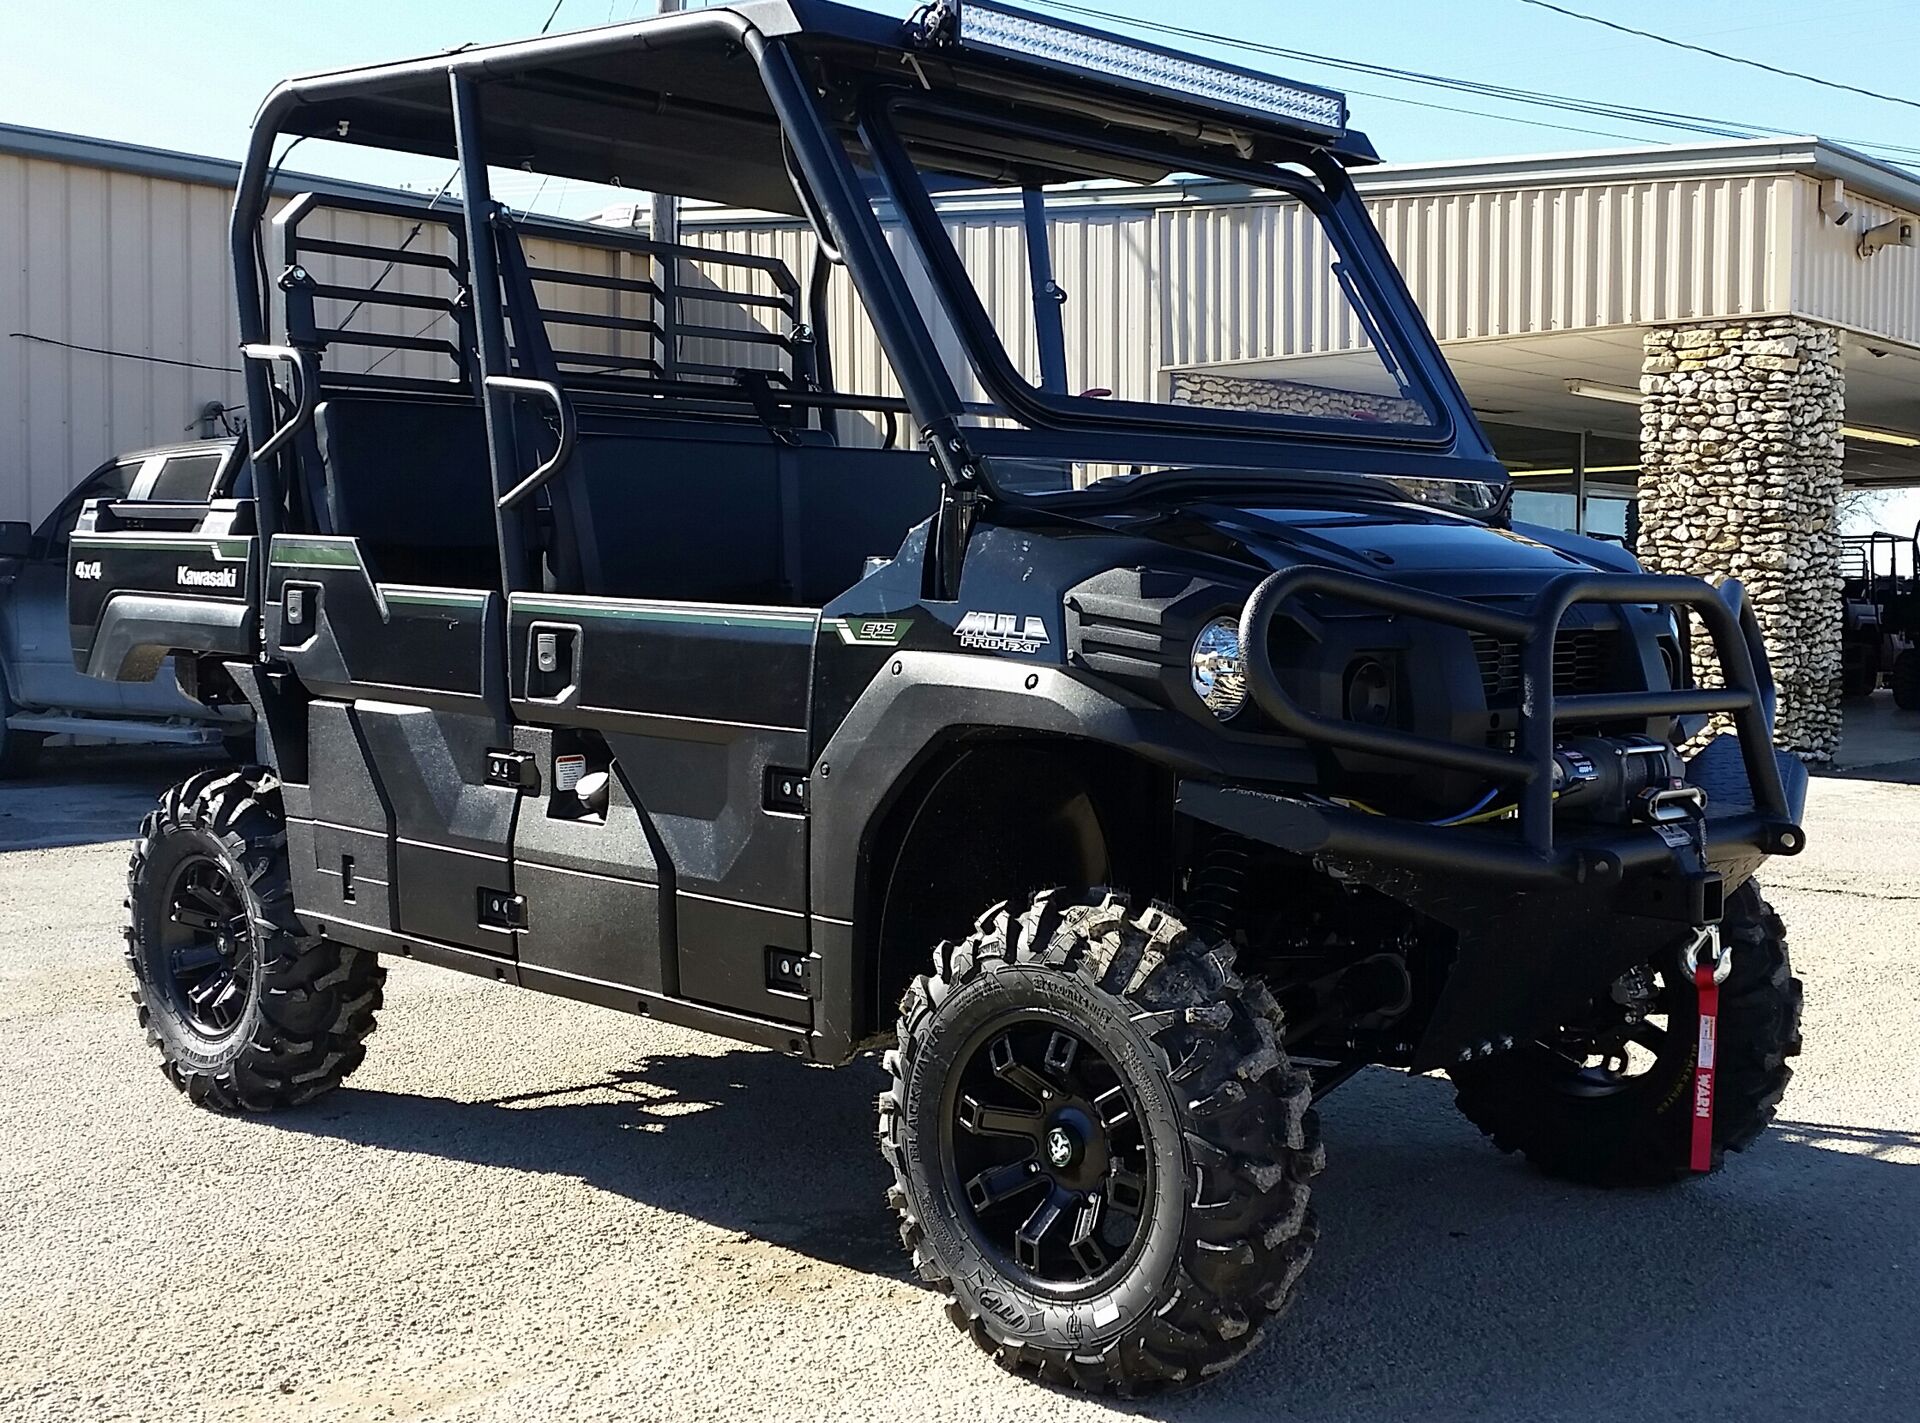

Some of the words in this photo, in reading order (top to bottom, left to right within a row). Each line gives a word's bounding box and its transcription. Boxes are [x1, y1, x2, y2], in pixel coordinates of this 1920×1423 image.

[75, 561, 102, 580] 4x4
[177, 566, 237, 588] Kawasaki
[861, 622, 897, 637] EPS
[953, 611, 1050, 644] MULE
[960, 636, 1040, 653] PRO-FXT
[1695, 1074, 1712, 1118] WARN
